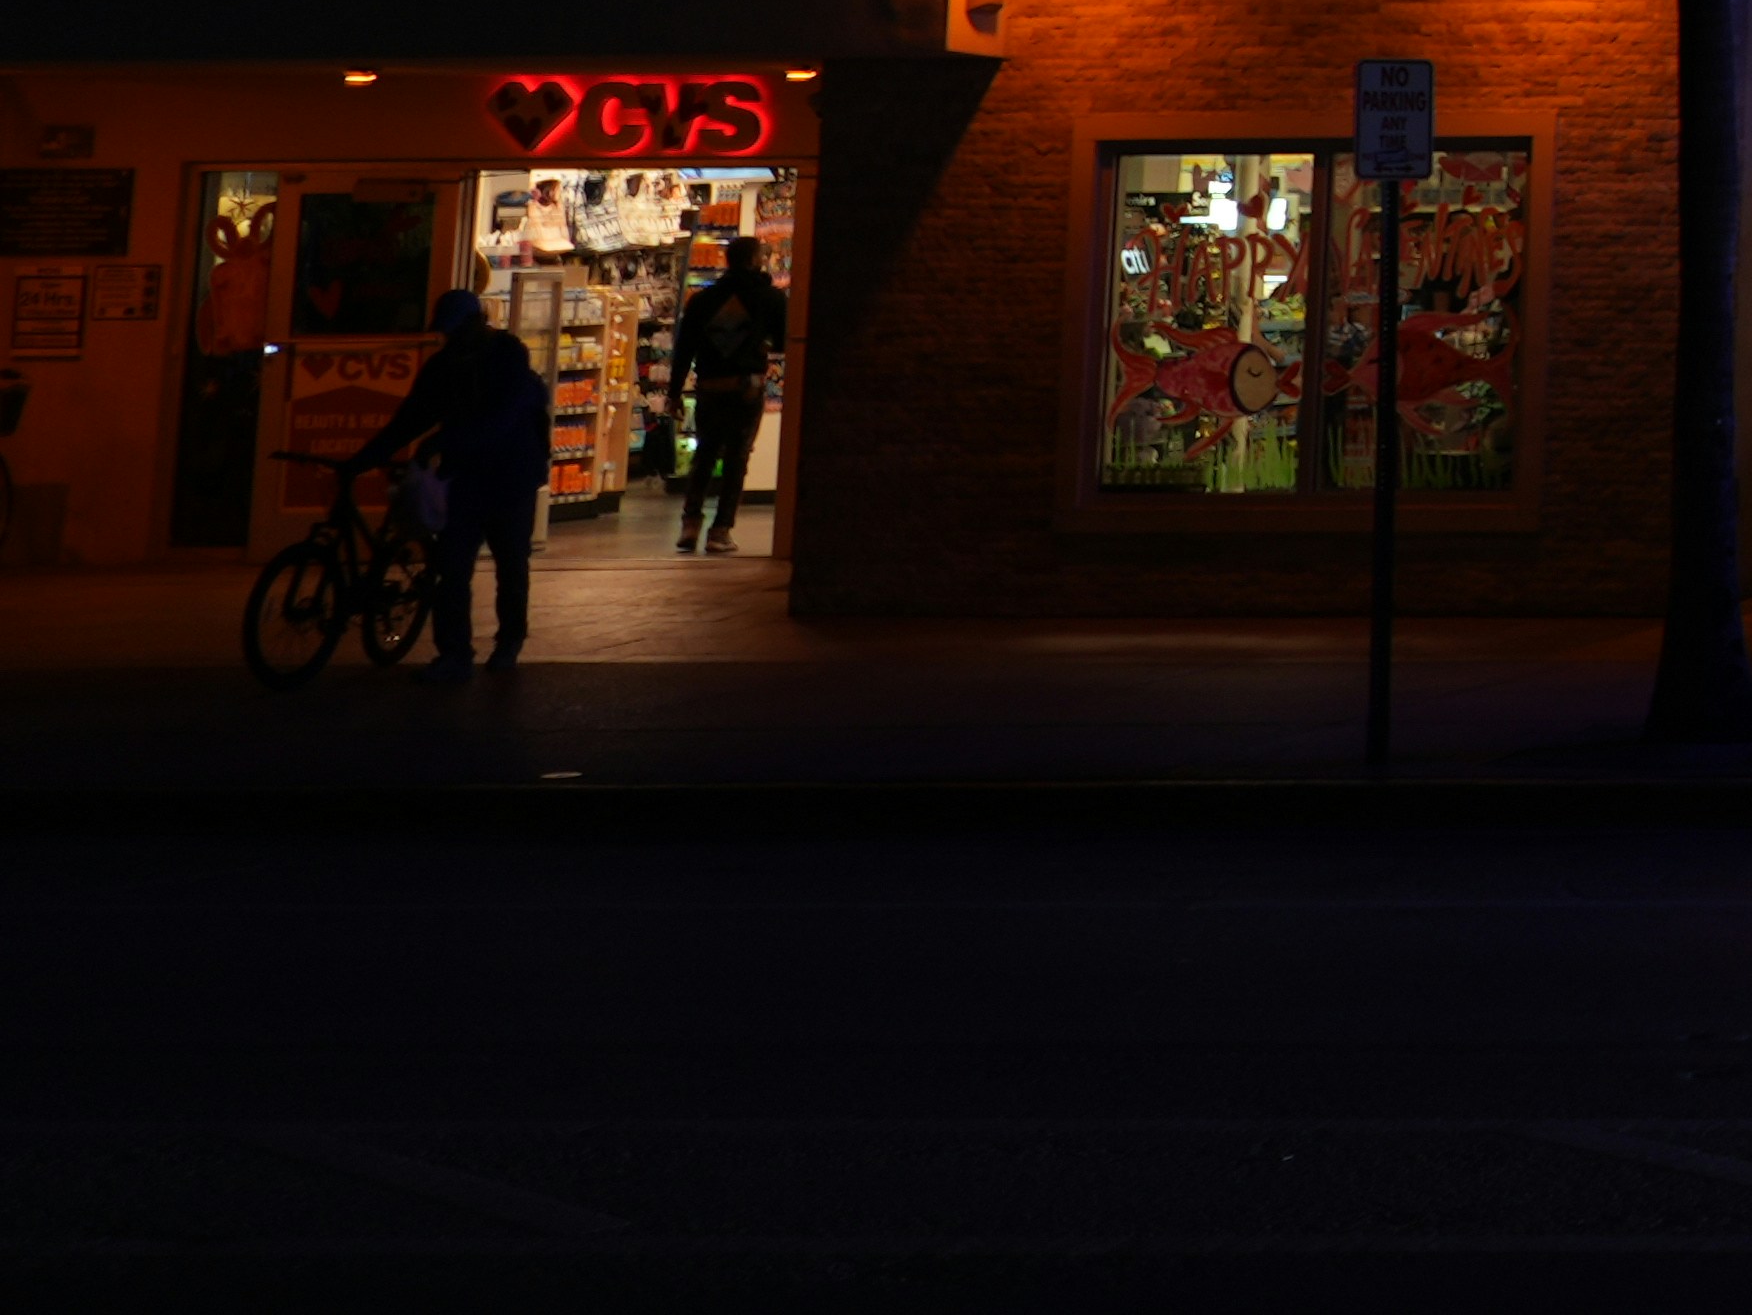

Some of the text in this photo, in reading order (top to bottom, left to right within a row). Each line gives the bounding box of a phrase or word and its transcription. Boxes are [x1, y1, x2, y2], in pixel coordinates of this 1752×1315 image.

[1381, 66, 1409, 87] NO
[1363, 91, 1426, 111] PARKING
[581, 77, 770, 157] CVS
[1382, 116, 1407, 130] ANY
[1379, 134, 1407, 148] TIME
[1132, 224, 1308, 314] HAPPY
[338, 352, 412, 380] CVS
[294, 414, 345, 430] BEAUTY
